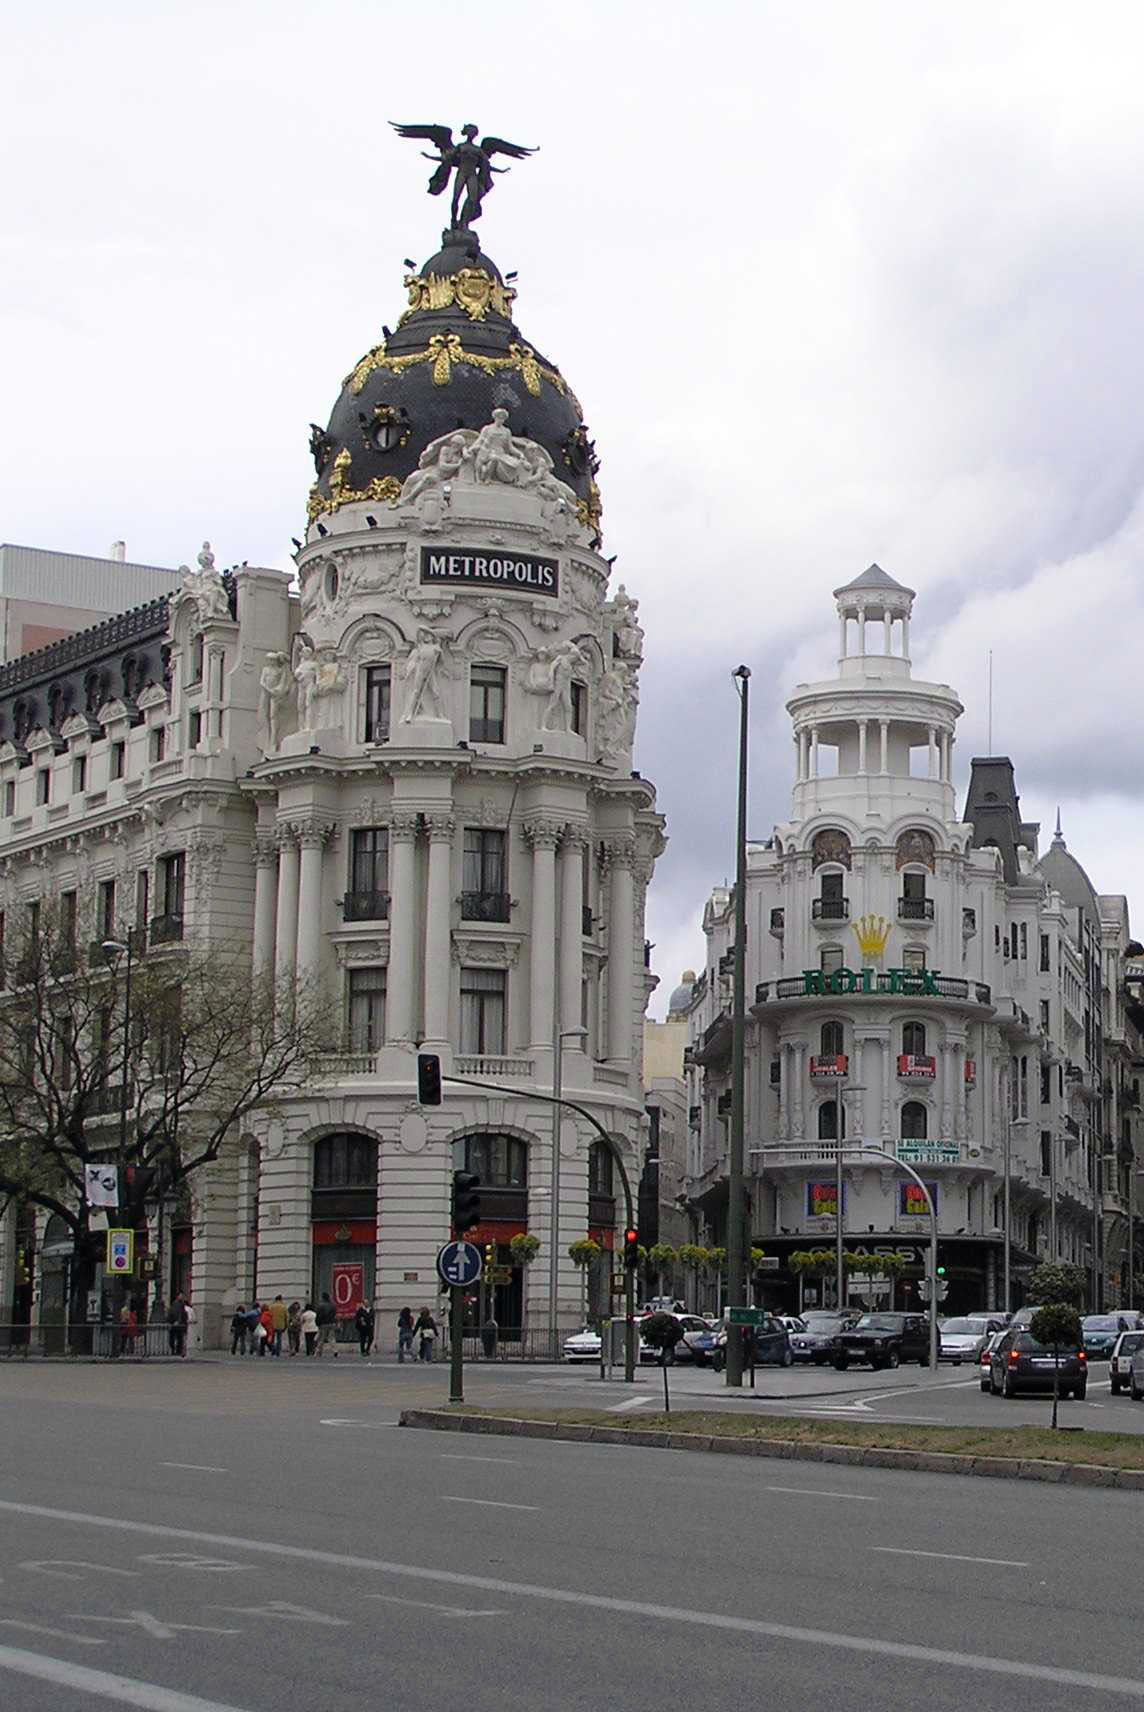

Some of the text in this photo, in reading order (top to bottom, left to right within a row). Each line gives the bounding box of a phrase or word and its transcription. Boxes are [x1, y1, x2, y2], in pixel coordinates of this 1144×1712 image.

[429, 555, 553, 586] METROPOLIS
[801, 967, 944, 996] ROLEX
[0, 1552, 257, 1582] BU
